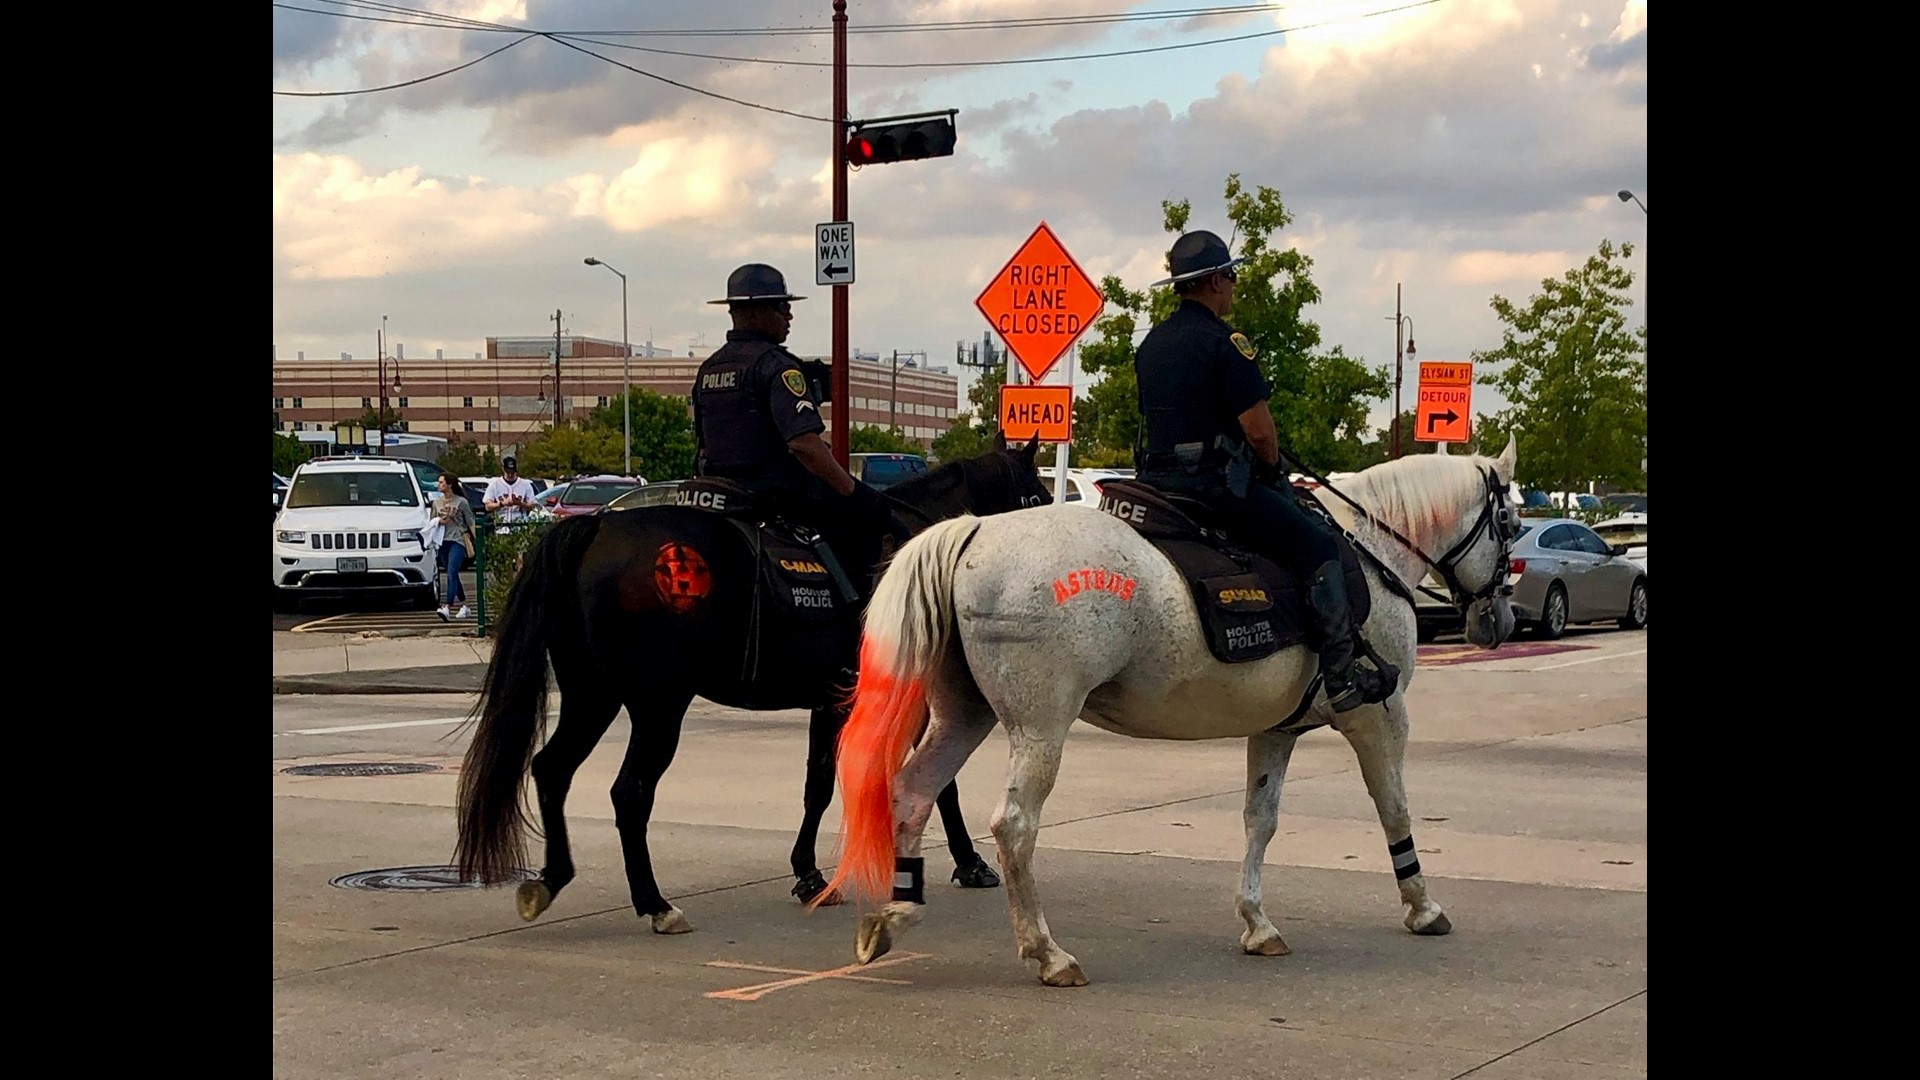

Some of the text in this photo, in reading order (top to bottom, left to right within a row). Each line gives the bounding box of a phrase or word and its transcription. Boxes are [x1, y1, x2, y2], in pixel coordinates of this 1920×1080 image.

[821, 227, 848, 243] ONE
[820, 244, 849, 260] WAY
[1010, 264, 1072, 286] RIGHT
[1013, 288, 1067, 310] LANE
[999, 313, 1080, 335] CLOSED
[702, 371, 736, 389] POLICE
[1421, 367, 1469, 380] ELYSIAN ST
[1421, 390, 1466, 403] DETOUR
[1006, 403, 1065, 424] AHEAD
[674, 490, 727, 510] OLICE
[793, 595, 834, 608] POLICE
[1228, 629, 1275, 651] POLICE
